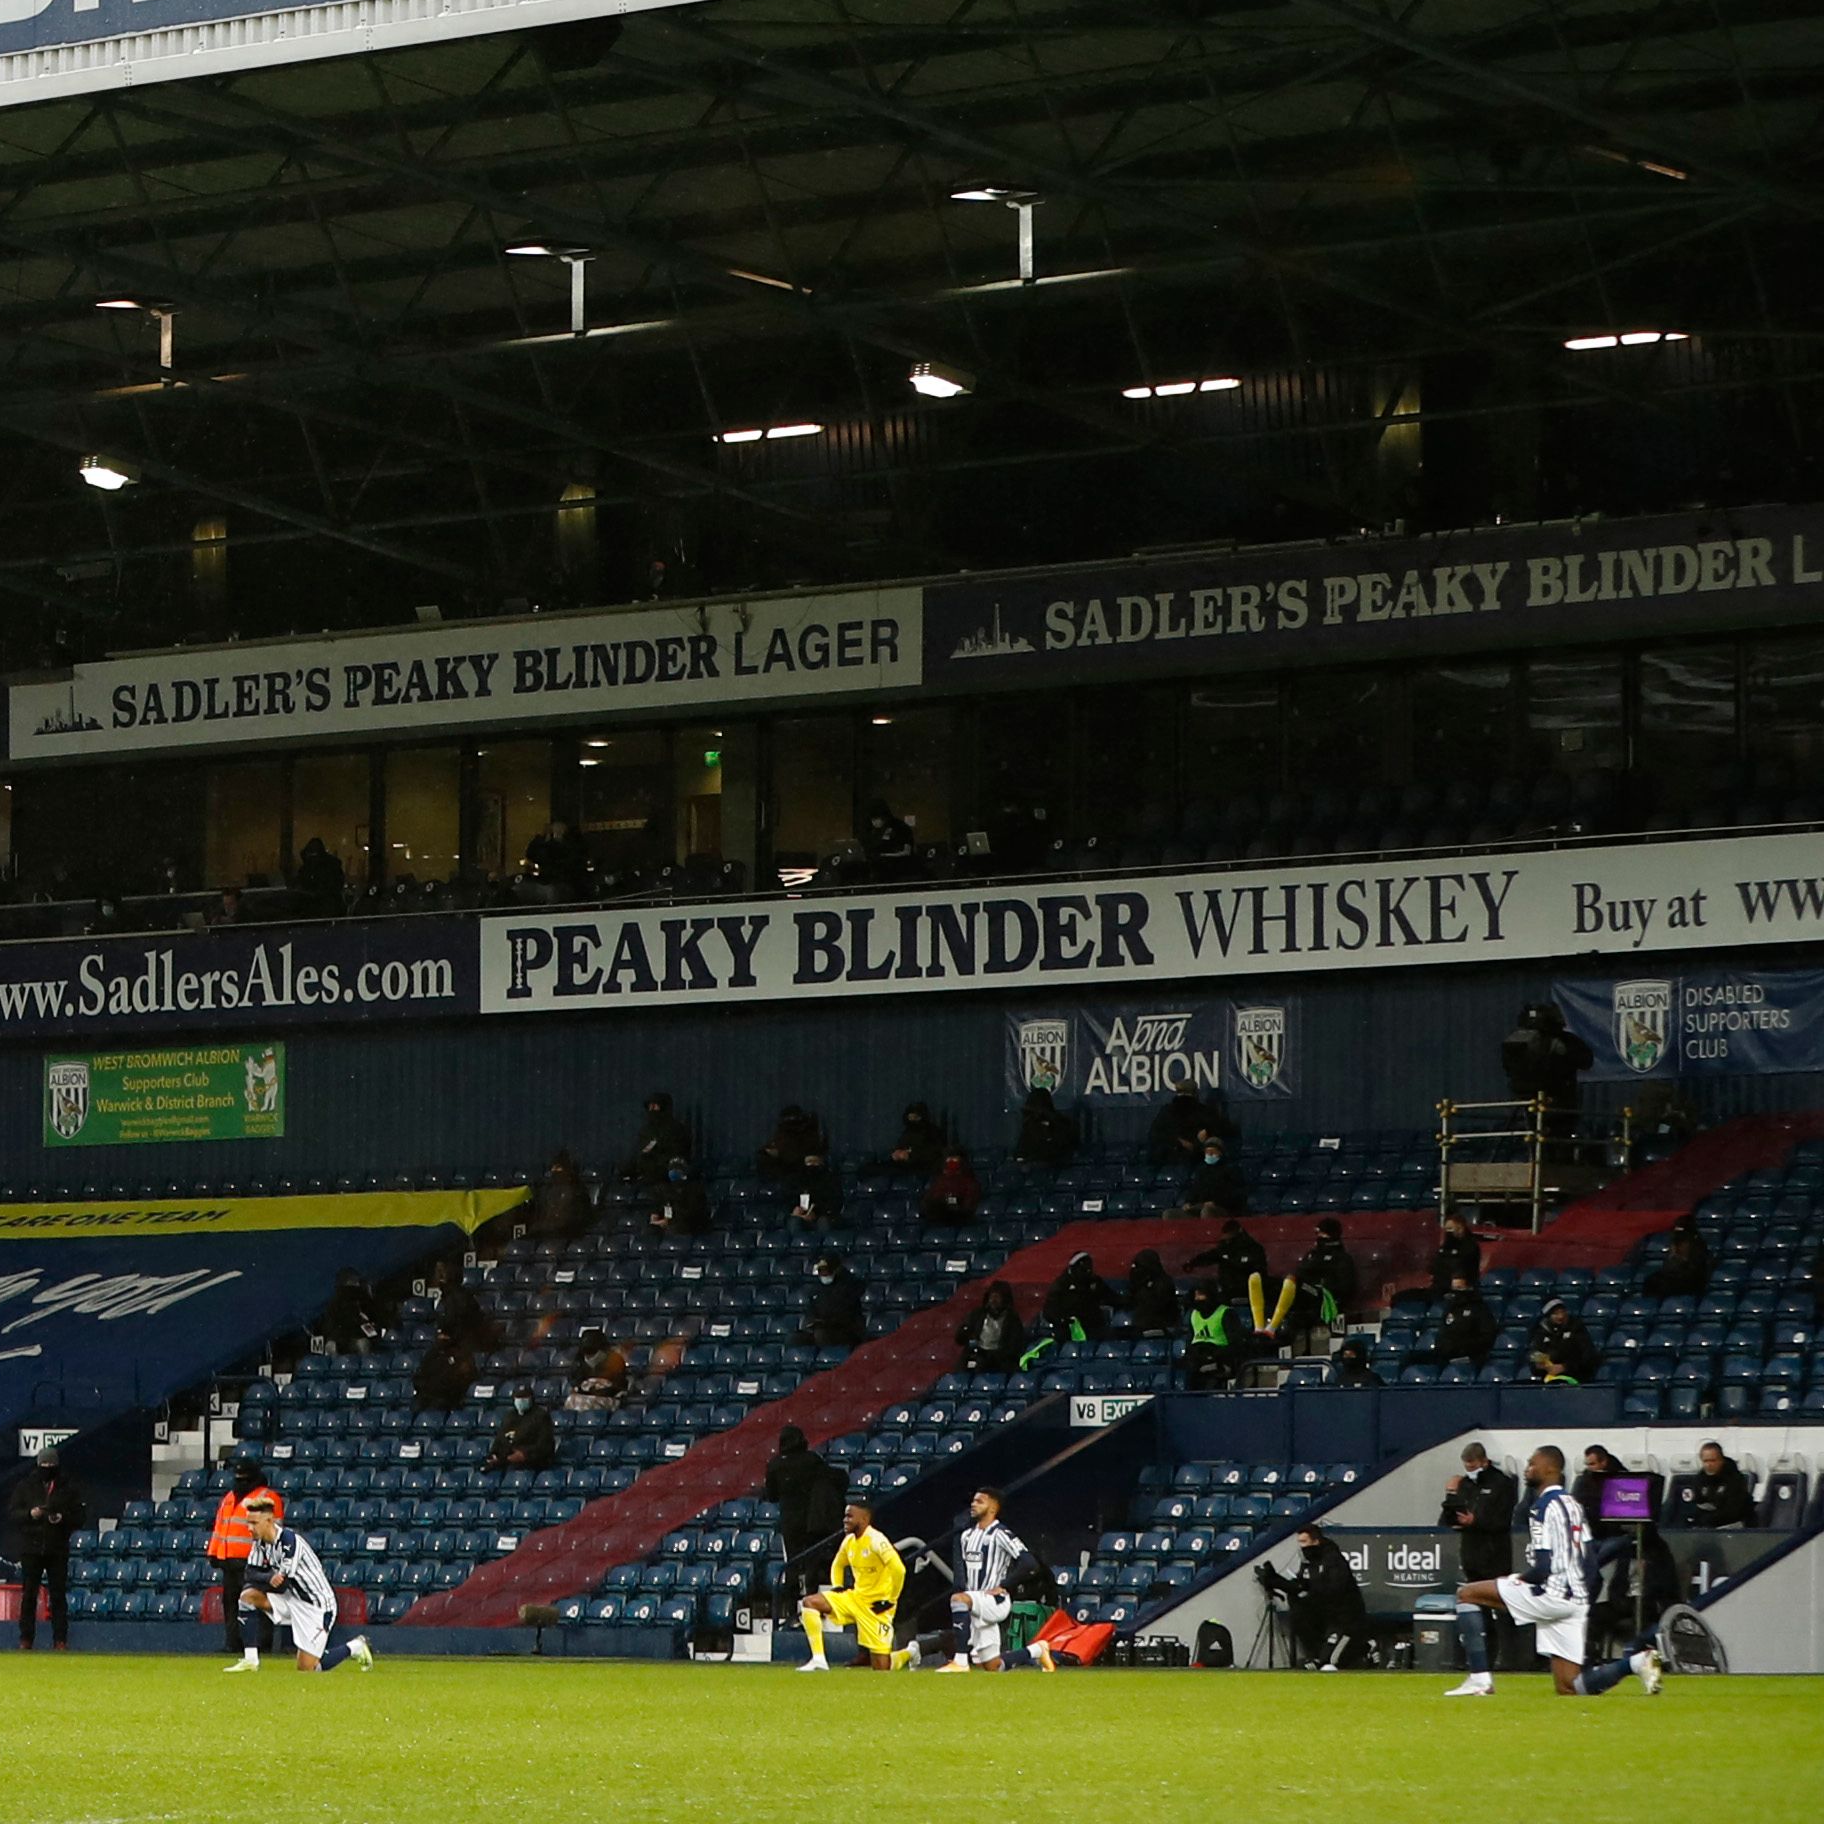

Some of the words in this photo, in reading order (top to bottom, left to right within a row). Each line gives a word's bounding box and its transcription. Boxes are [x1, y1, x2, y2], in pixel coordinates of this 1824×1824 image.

[1043, 577, 1310, 651] SADLER'S
[1323, 562, 1510, 625] PEAKY
[1526, 537, 1777, 607] BLINDER
[111, 666, 332, 729] SADLER'S
[344, 653, 499, 709] PEAKY
[512, 633, 720, 695] BLINDER
[733, 618, 900, 677] LAGER
[506, 914, 769, 1000] PEAKY
[793, 892, 1155, 985] BLINDER
[1176, 869, 1519, 960] WHISKEY
[1572, 881, 1661, 948] Buy
[1667, 885, 1707, 930] at
[1617, 994, 1667, 1009] ALBION
[1686, 985, 1763, 1006] DISABLED
[1238, 1019, 1281, 1032] ALBION
[1685, 1009, 1790, 1033] SUPPORTERS
[1022, 1031, 1064, 1045] ALBION
[1686, 1039, 1728, 1058] CLUB
[93, 1055, 123, 1070] WEST
[127, 1051, 193, 1069] BROMWICH
[196, 1049, 240, 1065] ALBION
[50, 1074, 85, 1086] ALBION
[122, 1074, 181, 1093] Supporters
[184, 1072, 209, 1087] Club
[1084, 1051, 1220, 1095] ALBION
[96, 1098, 142, 1113] Warwick
[145, 1097, 153, 1110] &
[157, 1095, 194, 1110] District
[196, 1093, 234, 1108] Branch
[2, 1213, 70, 1228] ARE
[64, 1211, 141, 1226] ONE
[136, 1208, 231, 1224] TEAM
[1076, 1403, 1096, 1420] V8
[1103, 1402, 1135, 1422] EXIT
[24, 1435, 38, 1450] V7
[1388, 1544, 1441, 1571] ideal
[1394, 1573, 1434, 1581] HEATING
[878, 1623, 890, 1636] 19
